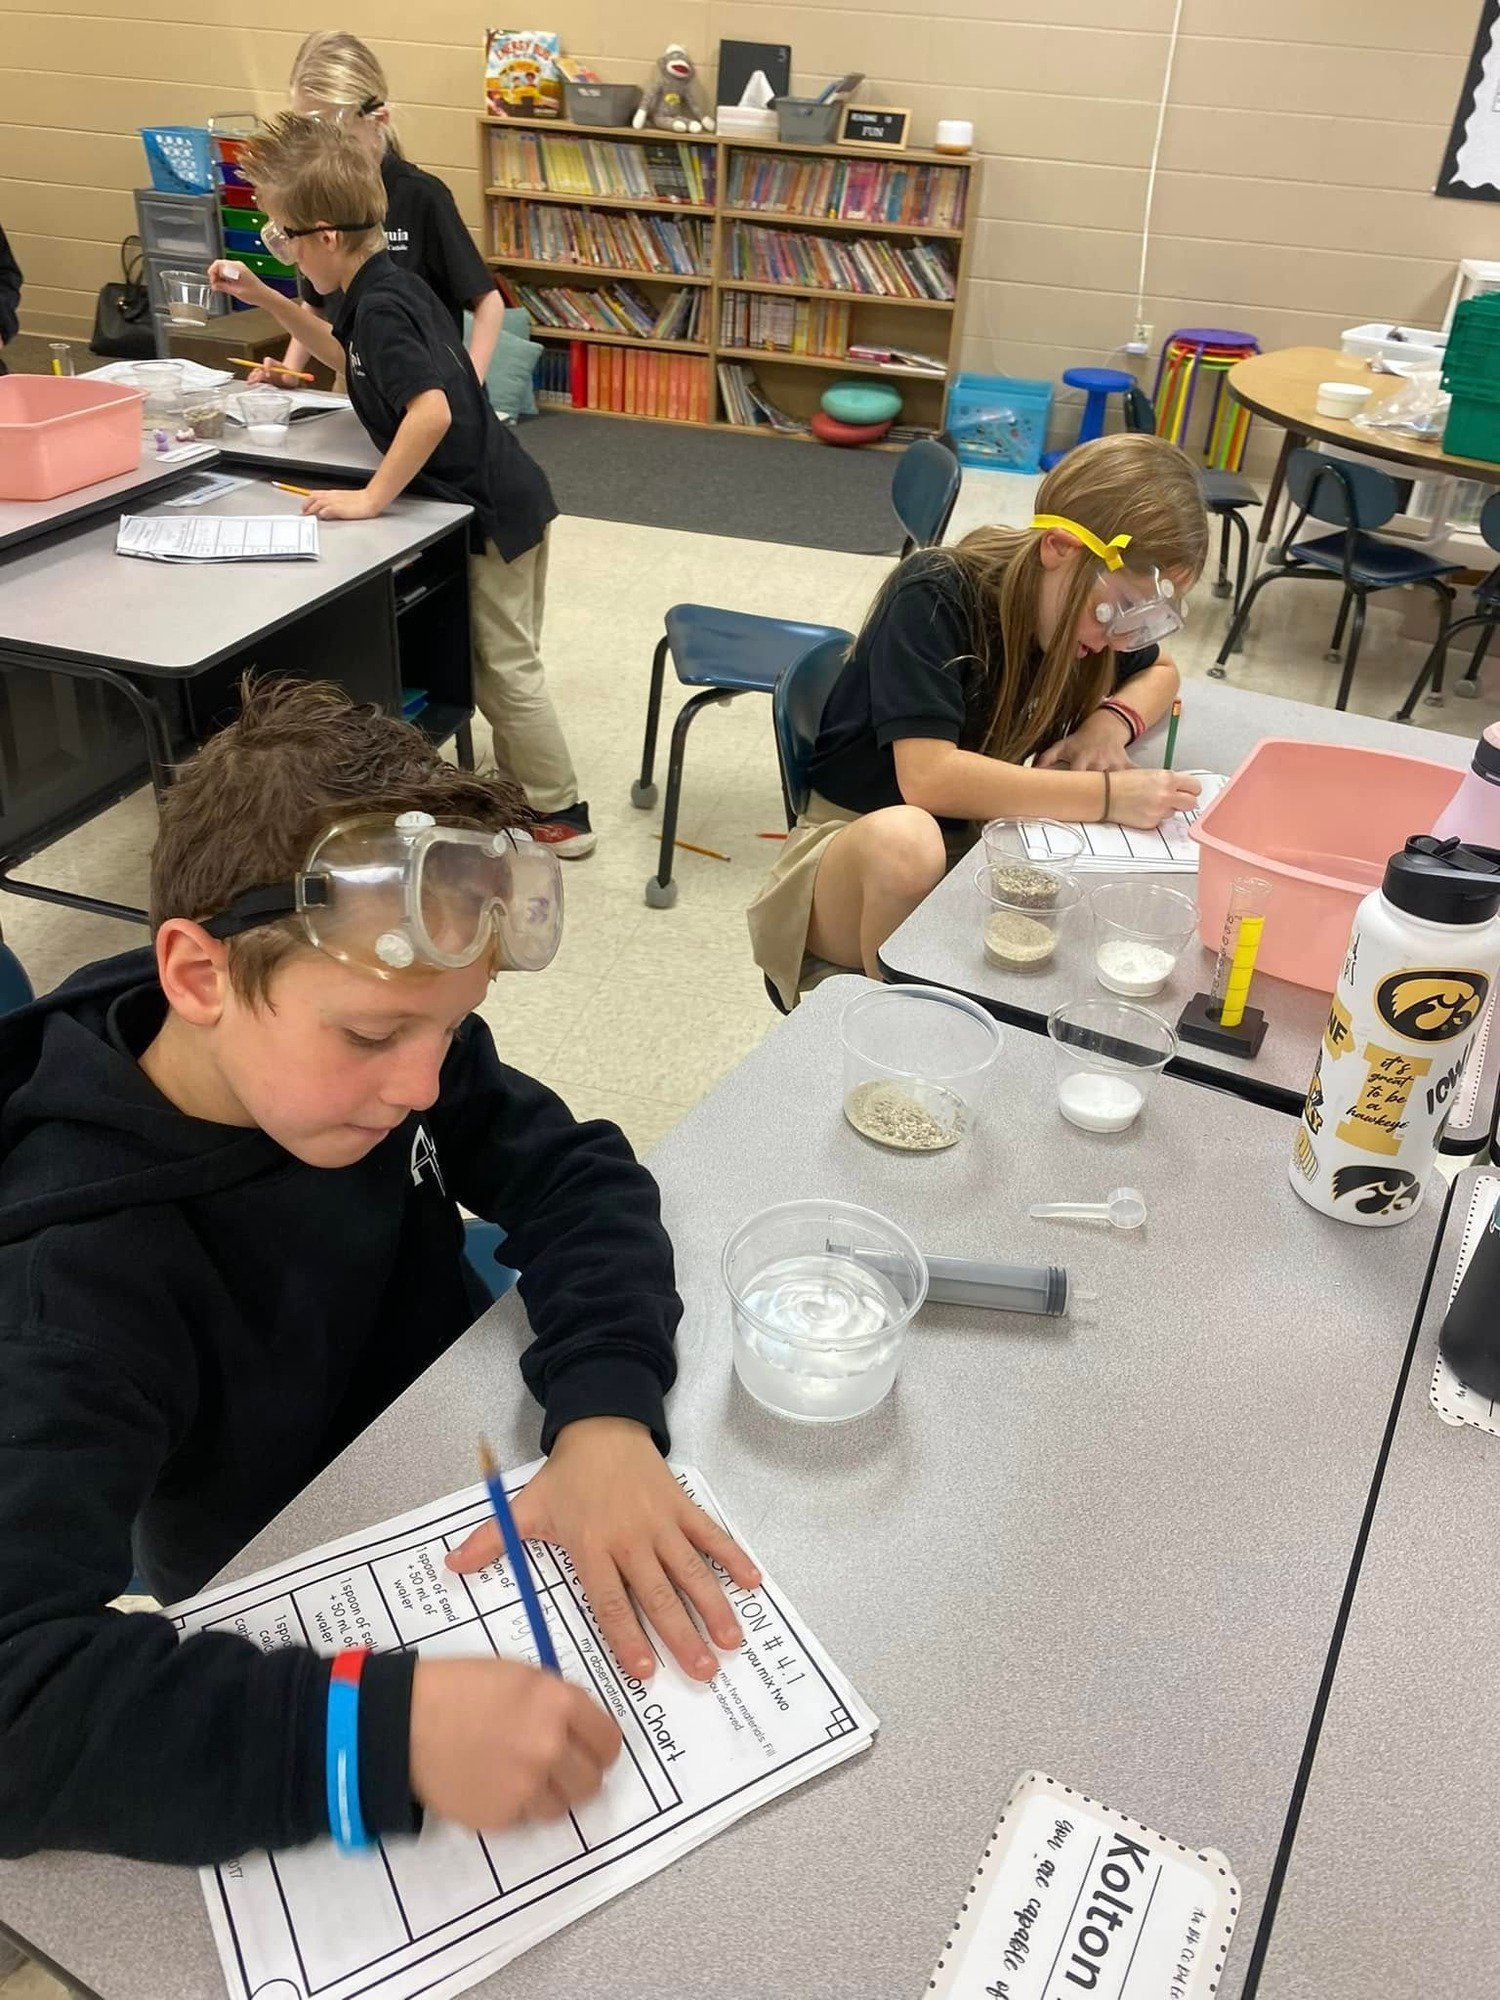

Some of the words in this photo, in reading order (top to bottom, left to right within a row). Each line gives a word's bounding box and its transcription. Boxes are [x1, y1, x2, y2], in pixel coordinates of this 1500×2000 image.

[1367, 1086, 1383, 1098] to
[1385, 1090, 1407, 1103] be
[1368, 1073, 1414, 1087] great
[1366, 1103, 1382, 1111] a
[418, 1553, 438, 1582] spoon
[500, 1577, 516, 1589] of
[394, 1579, 413, 1610] water
[409, 1571, 424, 1586] 50
[423, 1603, 438, 1615] of
[433, 1583, 448, 1595] of
[341, 1584, 362, 1616] spoon
[356, 1617, 371, 1629] of
[439, 1597, 461, 1623] sand
[275, 1622, 293, 1648] spoo
[315, 1611, 334, 1643] water
[331, 1602, 346, 1617] 50
[343, 1636, 359, 1648] of
[762, 1635, 784, 1651] #
[776, 1655, 806, 1686] 4.1
[581, 1637, 595, 1654] my
[589, 1655, 627, 1718] observations
[719, 1672, 732, 1689] mix
[729, 1687, 743, 1705] two
[741, 1648, 762, 1668] you
[756, 1667, 775, 1689] mix
[770, 1687, 790, 1712] two
[716, 1693, 745, 1731] observed
[643, 1703, 686, 1762] Chart
[1046, 1819, 1075, 1851] you
[227, 1860, 244, 1878] 017
[1034, 1859, 1056, 1889] are
[1065, 1832, 1151, 1990] Kolton
[1003, 1897, 1042, 1971] capable
